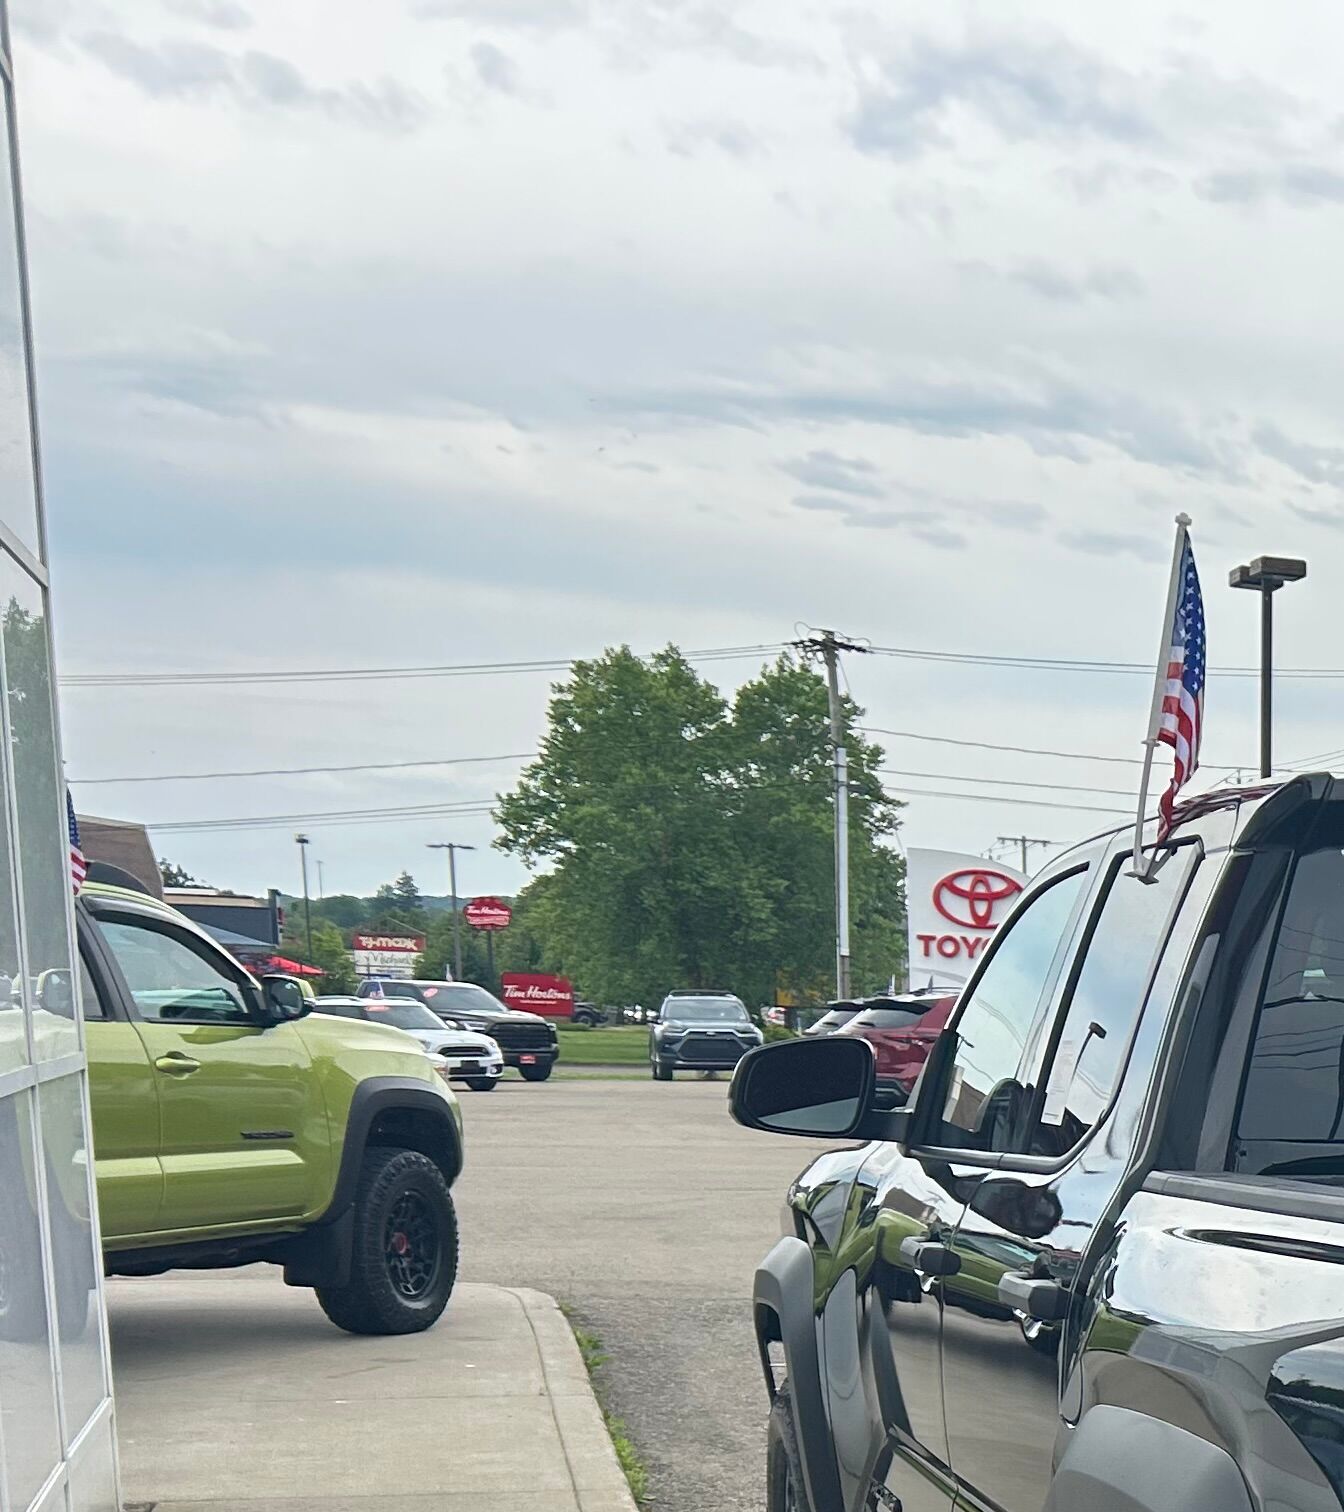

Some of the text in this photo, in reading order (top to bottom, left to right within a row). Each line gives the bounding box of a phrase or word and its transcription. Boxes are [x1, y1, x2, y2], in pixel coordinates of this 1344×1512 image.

[916, 935, 990, 958] TOY
[503, 985, 571, 1000] Tim Hortons
